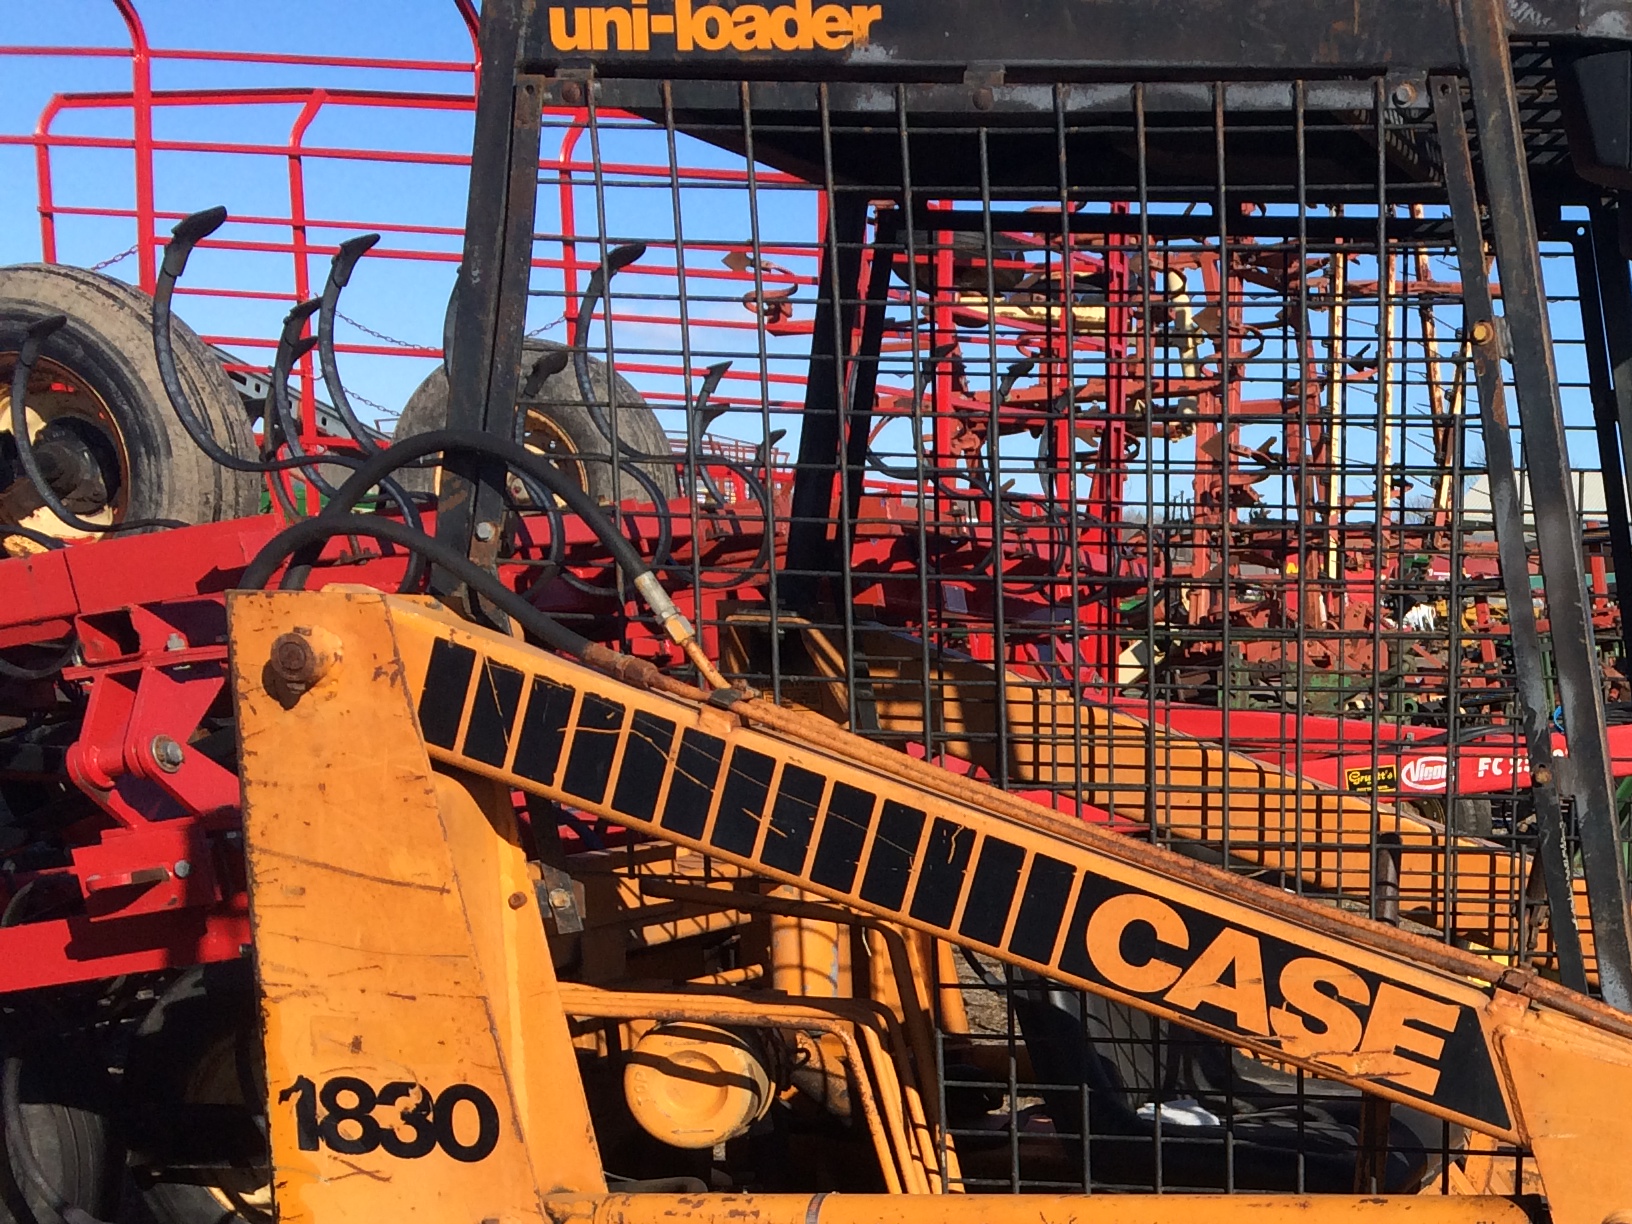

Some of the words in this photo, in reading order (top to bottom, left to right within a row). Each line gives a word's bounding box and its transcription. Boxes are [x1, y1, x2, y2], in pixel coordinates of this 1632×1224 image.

[548, 1, 883, 52] uni-loader
[1348, 769, 1394, 785] Grutt's
[1477, 757, 1504, 778] FC
[1085, 892, 1461, 1096] CASE
[277, 1074, 500, 1163] 1830
